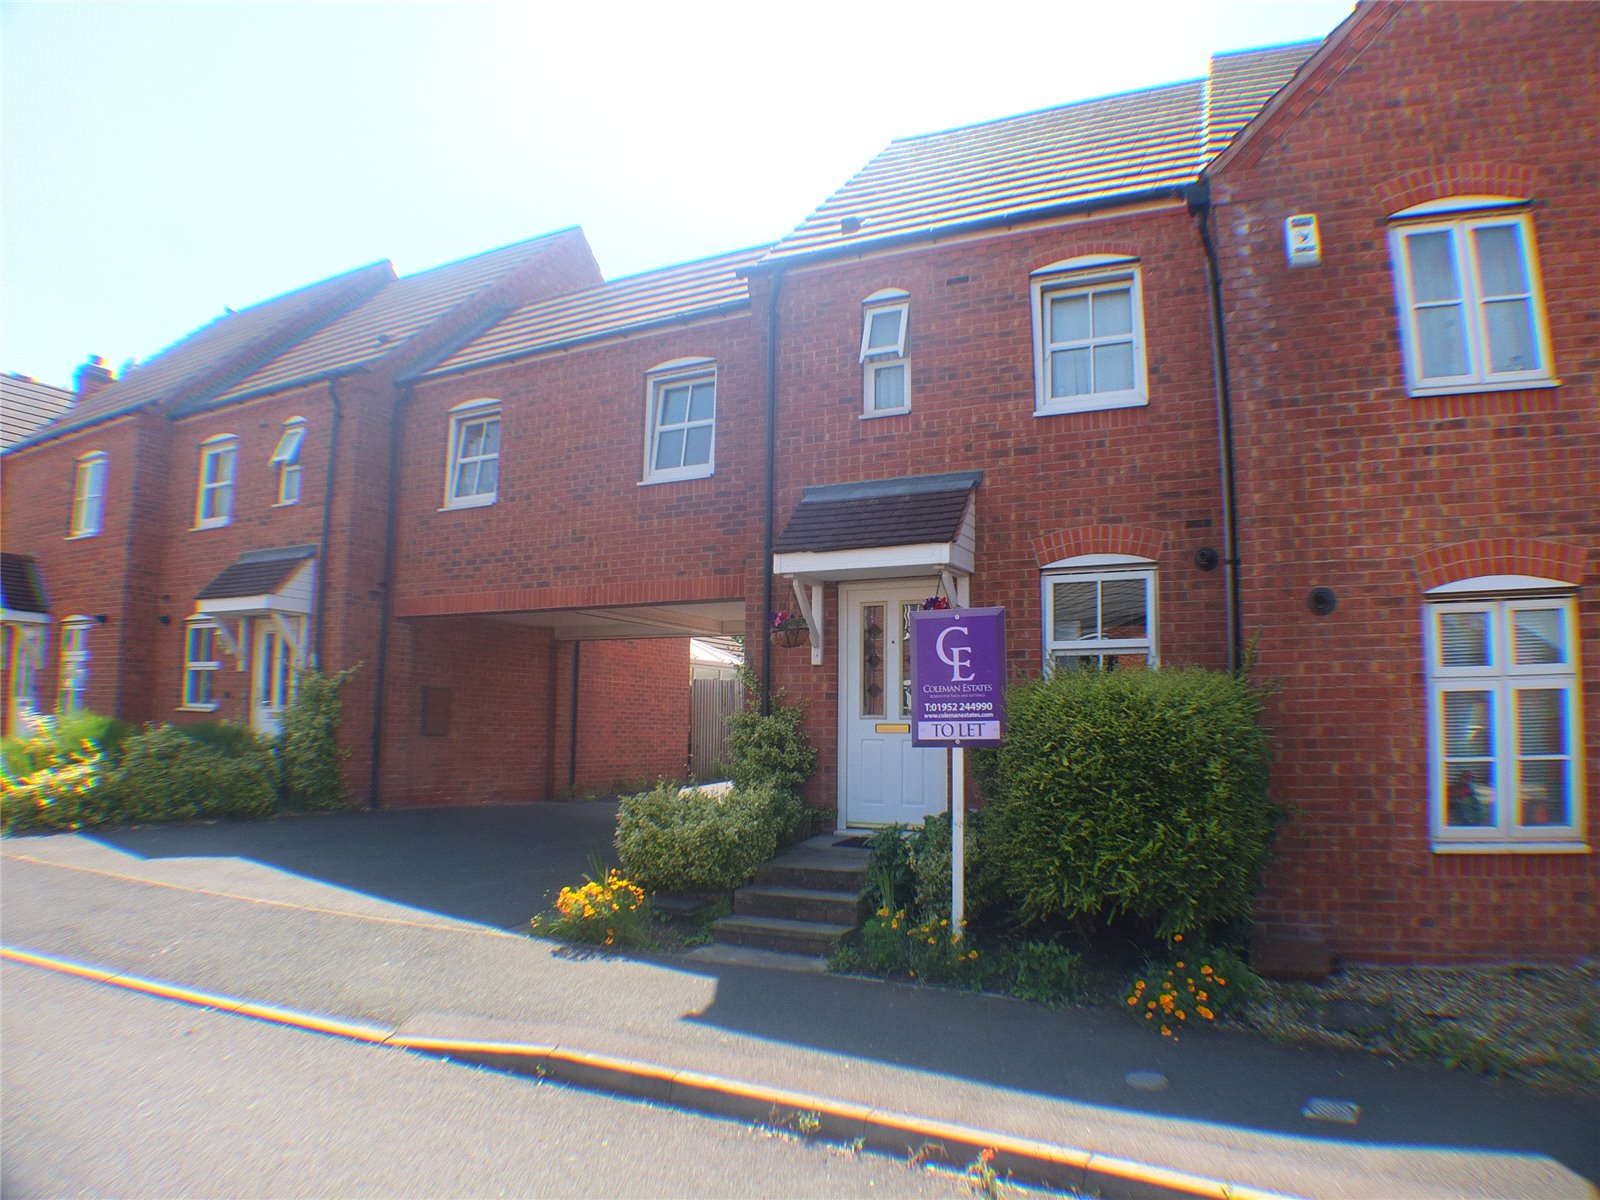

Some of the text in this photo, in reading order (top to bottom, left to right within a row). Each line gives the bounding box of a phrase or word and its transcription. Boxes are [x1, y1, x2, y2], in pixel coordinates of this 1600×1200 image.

[923, 684, 993, 693] COLEMAN ESTATES
[924, 702, 993, 712] T:01952 244990
[931, 723, 986, 737] TO LET
